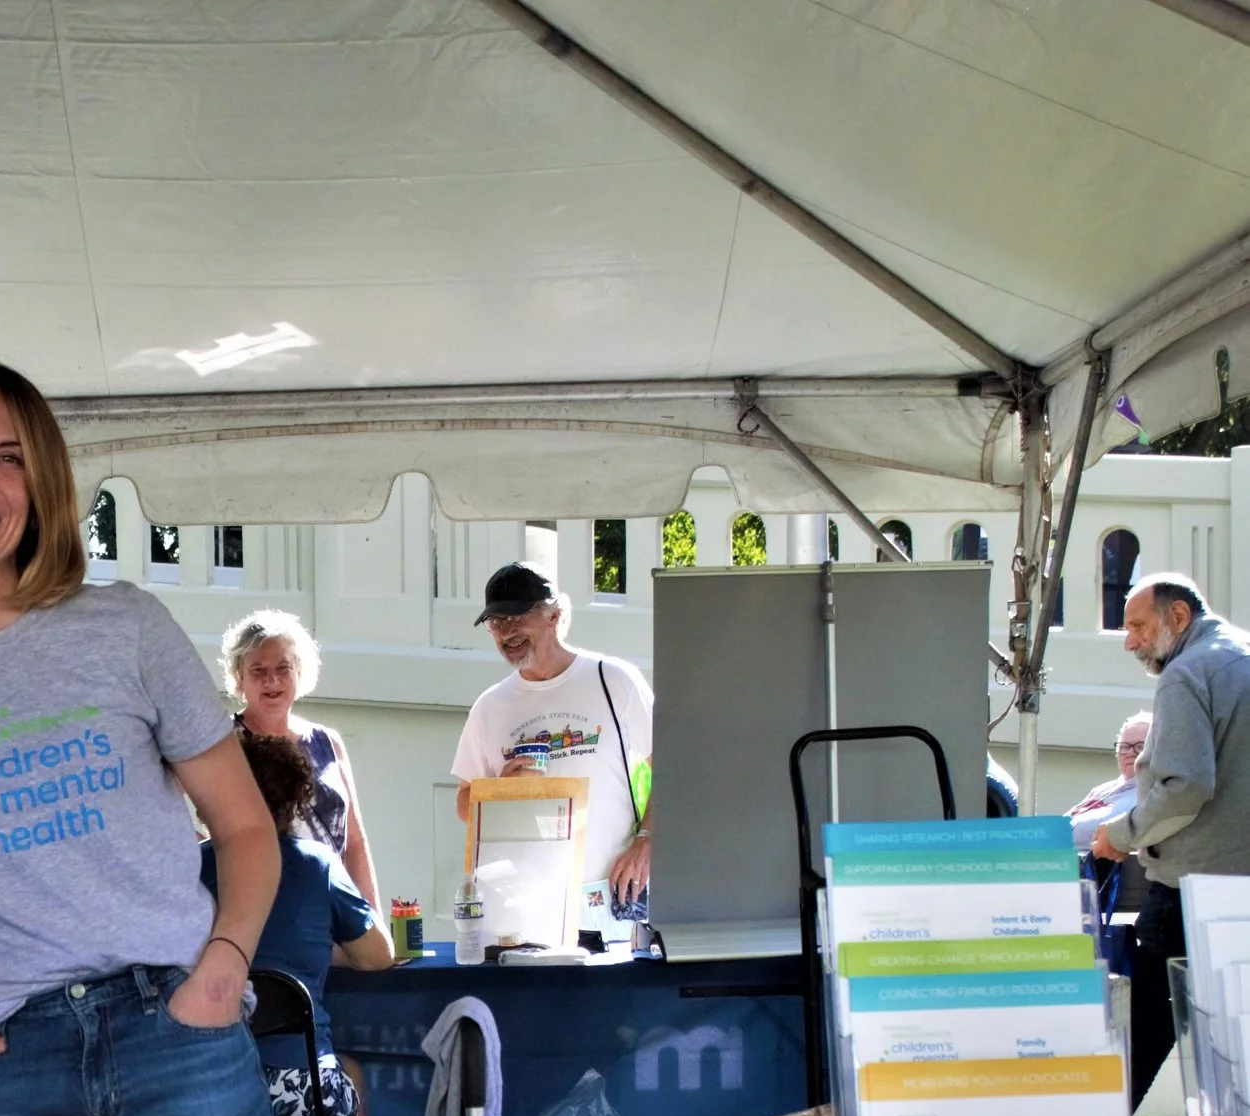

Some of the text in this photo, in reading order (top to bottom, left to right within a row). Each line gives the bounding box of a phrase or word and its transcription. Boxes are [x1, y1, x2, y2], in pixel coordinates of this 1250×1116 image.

[510, 712, 588, 737] MINNESOTA STATE FAIR
[0, 757, 124, 814] mental
[962, 831, 987, 841] BEST
[992, 915, 1019, 925] Infant
[1030, 915, 1052, 926] Early
[1016, 1038, 1046, 1048] Family
